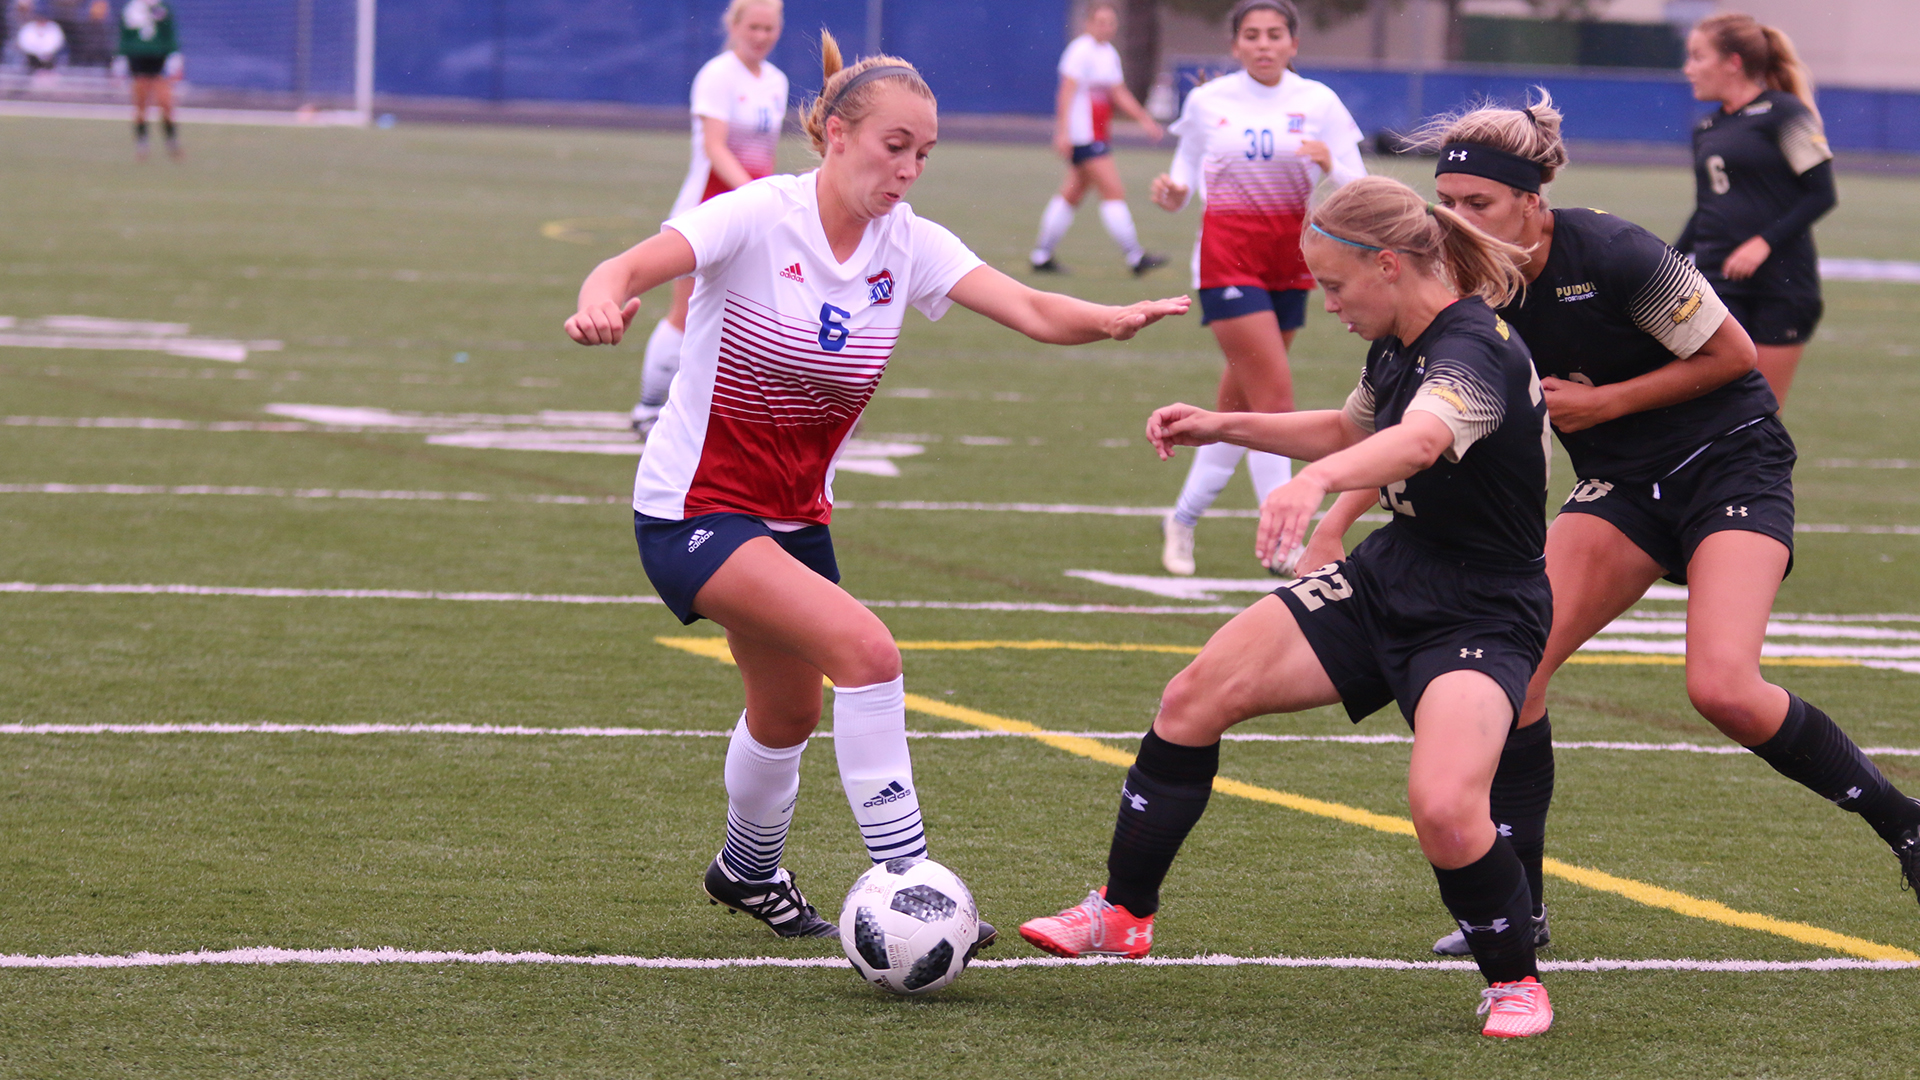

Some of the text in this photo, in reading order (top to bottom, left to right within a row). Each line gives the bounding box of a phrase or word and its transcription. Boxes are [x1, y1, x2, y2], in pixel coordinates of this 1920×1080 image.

[1244, 128, 1274, 161] 30
[1706, 155, 1731, 195] 6
[779, 271, 805, 283] adidas
[818, 302, 850, 352] 6
[687, 530, 714, 553] adidas
[863, 788, 911, 808] adidas
